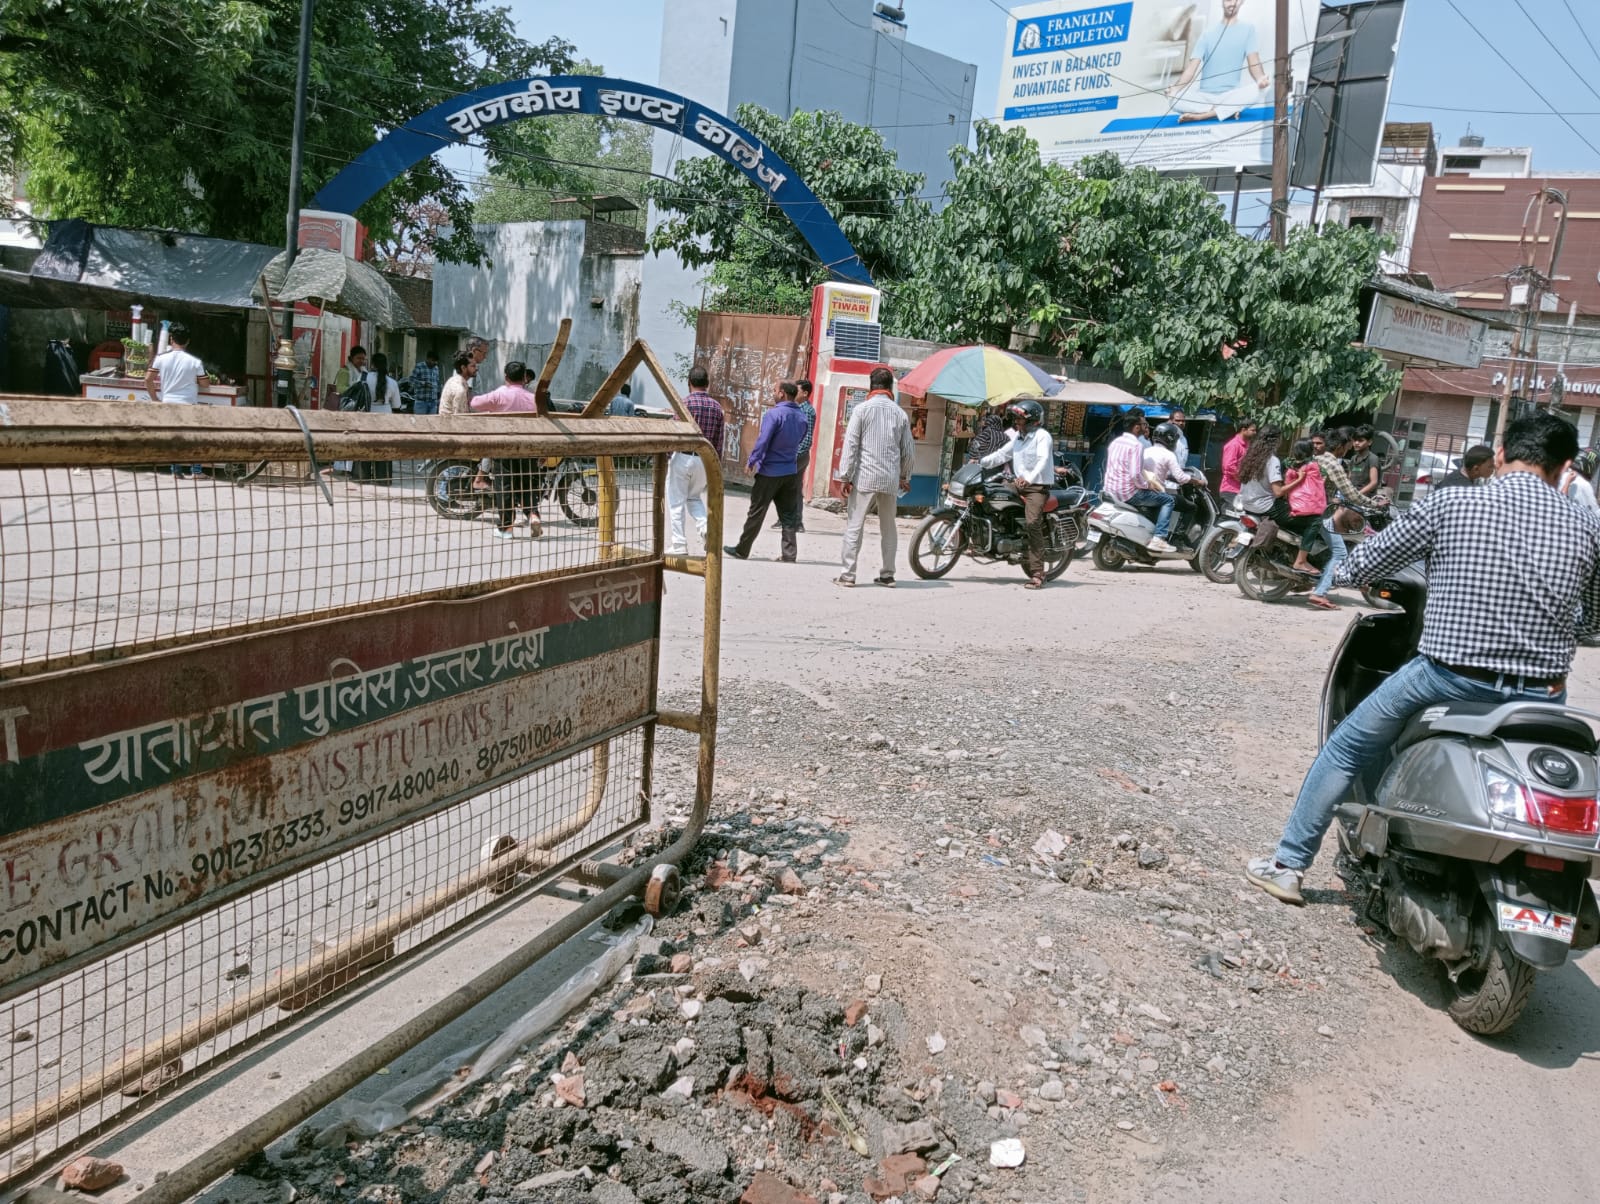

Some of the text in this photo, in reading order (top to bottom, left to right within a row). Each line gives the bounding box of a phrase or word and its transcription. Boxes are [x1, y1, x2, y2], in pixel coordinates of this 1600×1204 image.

[1047, 10, 1115, 32] FRANKLIN
[1046, 24, 1125, 48] TEMPLETON
[1012, 51, 1121, 79] INVEST IN BALANCED
[1013, 73, 1113, 98] ADVANTAGE FUNDS.
[445, 80, 582, 136] राजकीय
[597, 88, 684, 124] इण्टर
[832, 301, 870, 313] TIWARI
[1392, 305, 1422, 329] SHANTI
[1422, 312, 1445, 335] STEEL
[78, 692, 287, 784] यातायात
[408, 642, 487, 698] उत्तर
[487, 621, 550, 679] प्रदेश
[1514, 908, 1573, 928] A/F
